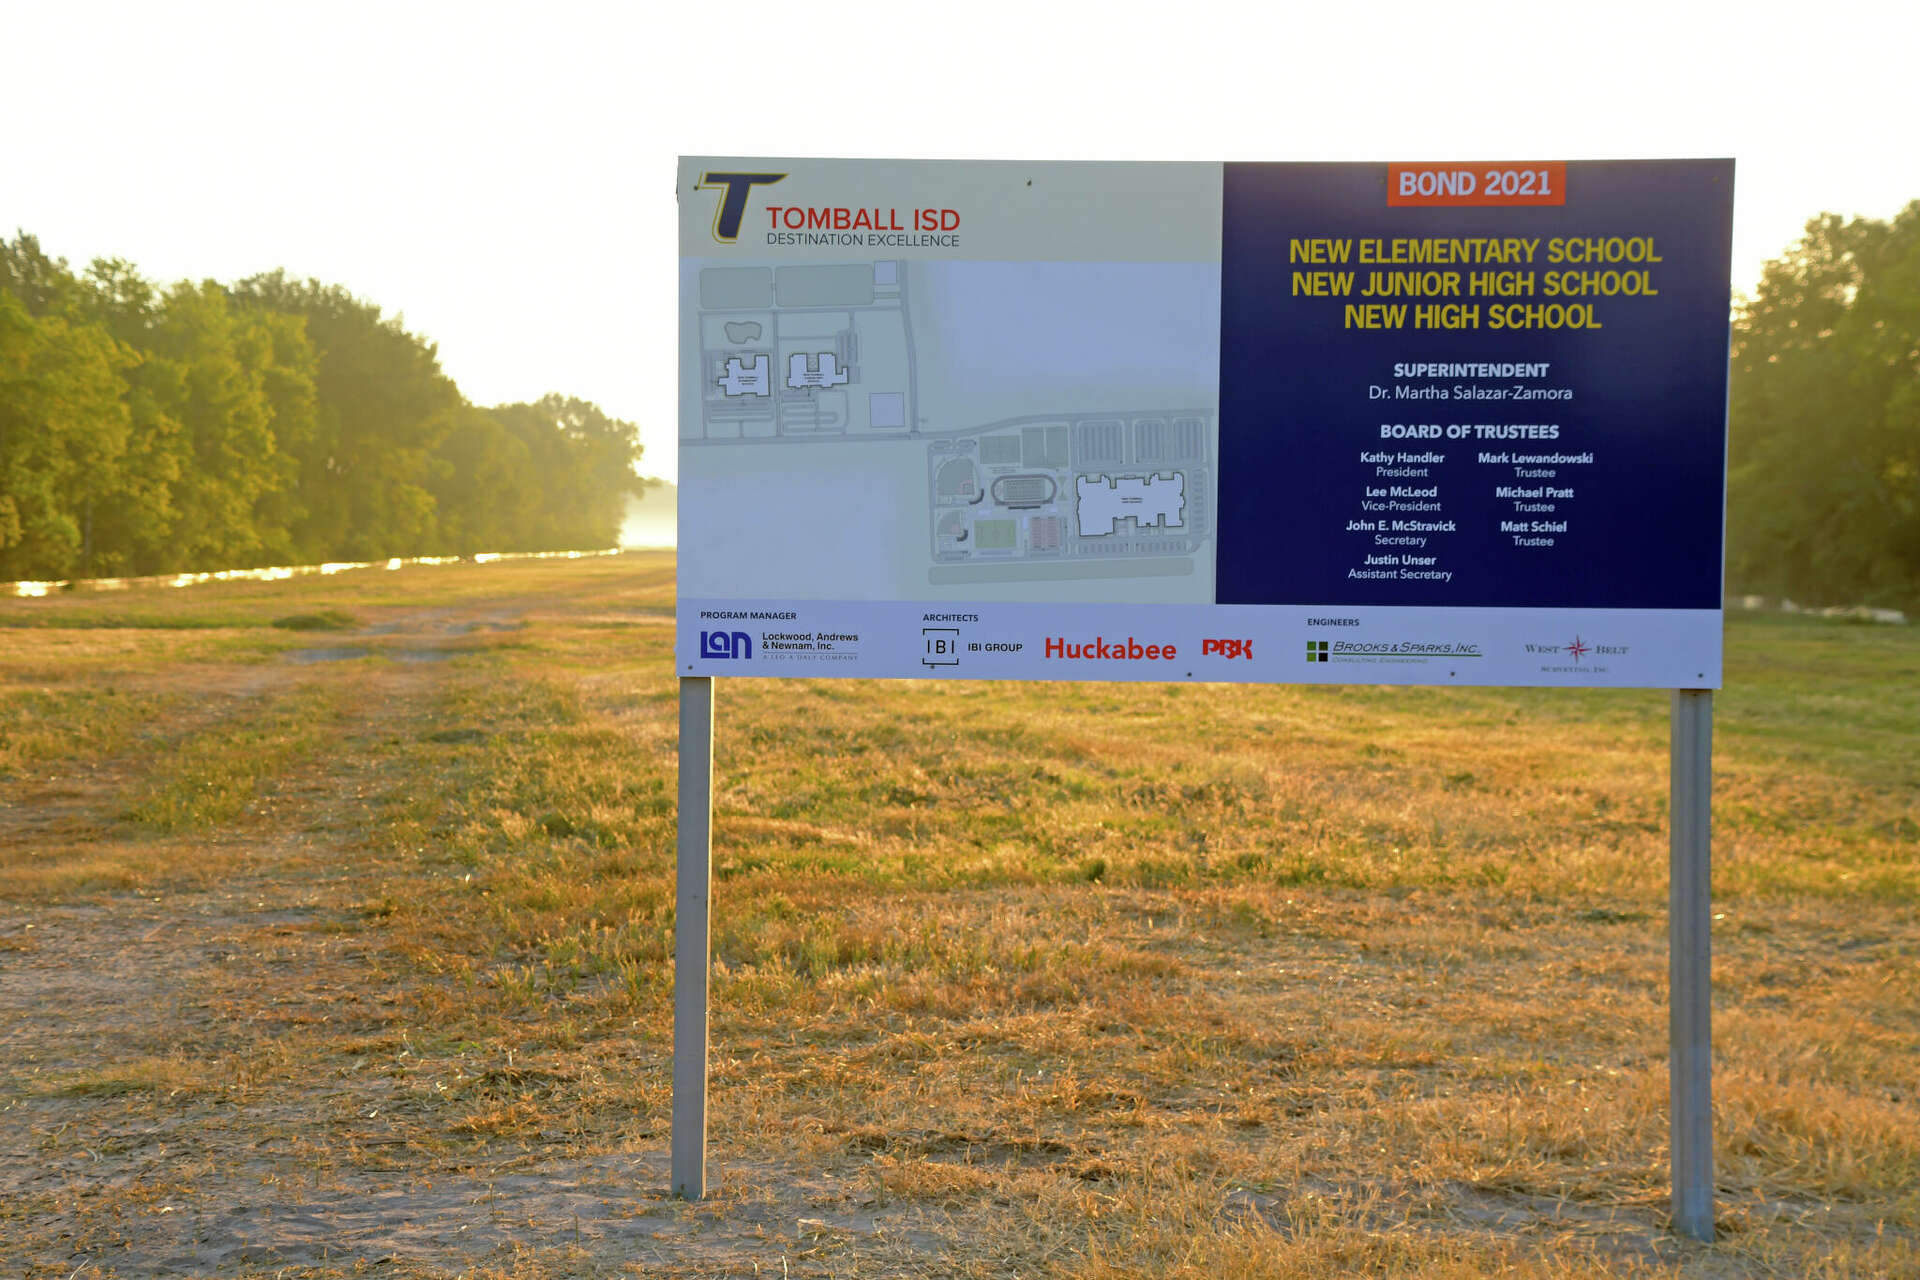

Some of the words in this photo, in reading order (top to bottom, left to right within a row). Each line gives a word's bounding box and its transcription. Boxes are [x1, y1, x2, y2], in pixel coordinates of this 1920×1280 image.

[1399, 171, 1476, 196] BOND
[1484, 170, 1551, 195] 2021
[766, 207, 904, 230] TOMBALL
[914, 209, 960, 231] ISD
[767, 232, 863, 246] DESTINATION
[868, 234, 960, 247] EXCELLENCE
[1289, 239, 1352, 264] NEW
[1359, 238, 1540, 263] ELEMENTARY
[1547, 237, 1663, 263] SCHOOL
[1292, 272, 1354, 296] NEW
[1361, 271, 1460, 296] JUNIOR
[1469, 271, 1535, 296] HIGH
[1543, 271, 1659, 296] SCHOOL
[1344, 305, 1407, 329] NEW
[1415, 304, 1479, 329] HIGH
[1488, 304, 1602, 329] SCHOOL
[1393, 363, 1550, 378] SUPERINTENDENT
[1368, 386, 1391, 400] Dr.
[1395, 386, 1449, 400] Martha
[1453, 386, 1573, 400] Salazar-Zamora
[1380, 425, 1442, 439] BOARD
[1446, 425, 1471, 439] OF
[1474, 425, 1560, 439] TRUSTEES
[1360, 452, 1394, 466] Kathy
[1397, 452, 1445, 463] Handler
[1478, 453, 1509, 464] Mark
[1511, 453, 1594, 464] Lewandowski
[1376, 467, 1428, 477] President
[1514, 467, 1556, 478] Trustee
[1366, 486, 1387, 498] Lee
[1390, 486, 1437, 498] McLeod
[1496, 487, 1543, 498] Michael
[1546, 487, 1574, 498] Pratt
[1361, 501, 1441, 512] Vice-President
[1513, 502, 1555, 512] Trustee
[1346, 520, 1375, 532] John
[1378, 521, 1389, 531] E.
[1392, 521, 1456, 532] McStravick
[1501, 521, 1528, 532] Matt
[1531, 521, 1567, 532] Schiel
[1374, 535, 1427, 547] Secretary
[1513, 536, 1554, 547] Trustee
[1364, 555, 1399, 566] Justin
[1402, 555, 1437, 566] Unser
[1348, 569, 1397, 580] Assistant
[1400, 569, 1452, 582] Secretary
[700, 610, 748, 620] PROGRAM
[750, 611, 797, 621] MANAGER
[922, 614, 979, 622] ARCHITECTS
[1307, 618, 1360, 627] ENGINEERS
[762, 632, 815, 643] Lockwood,
[816, 632, 859, 642] Andrews
[762, 641, 769, 650] &
[771, 641, 816, 651] Newnam,
[817, 642, 835, 651] Inc.
[968, 643, 982, 652] IBI
[985, 643, 1023, 652] GROUP
[1045, 637, 1177, 660] Huckabee
[1202, 639, 1253, 659] PBK
[1333, 641, 1388, 652] BROOKS
[1391, 643, 1399, 652] &
[1525, 644, 1560, 654] WEST
[1596, 645, 1629, 655] BELT
